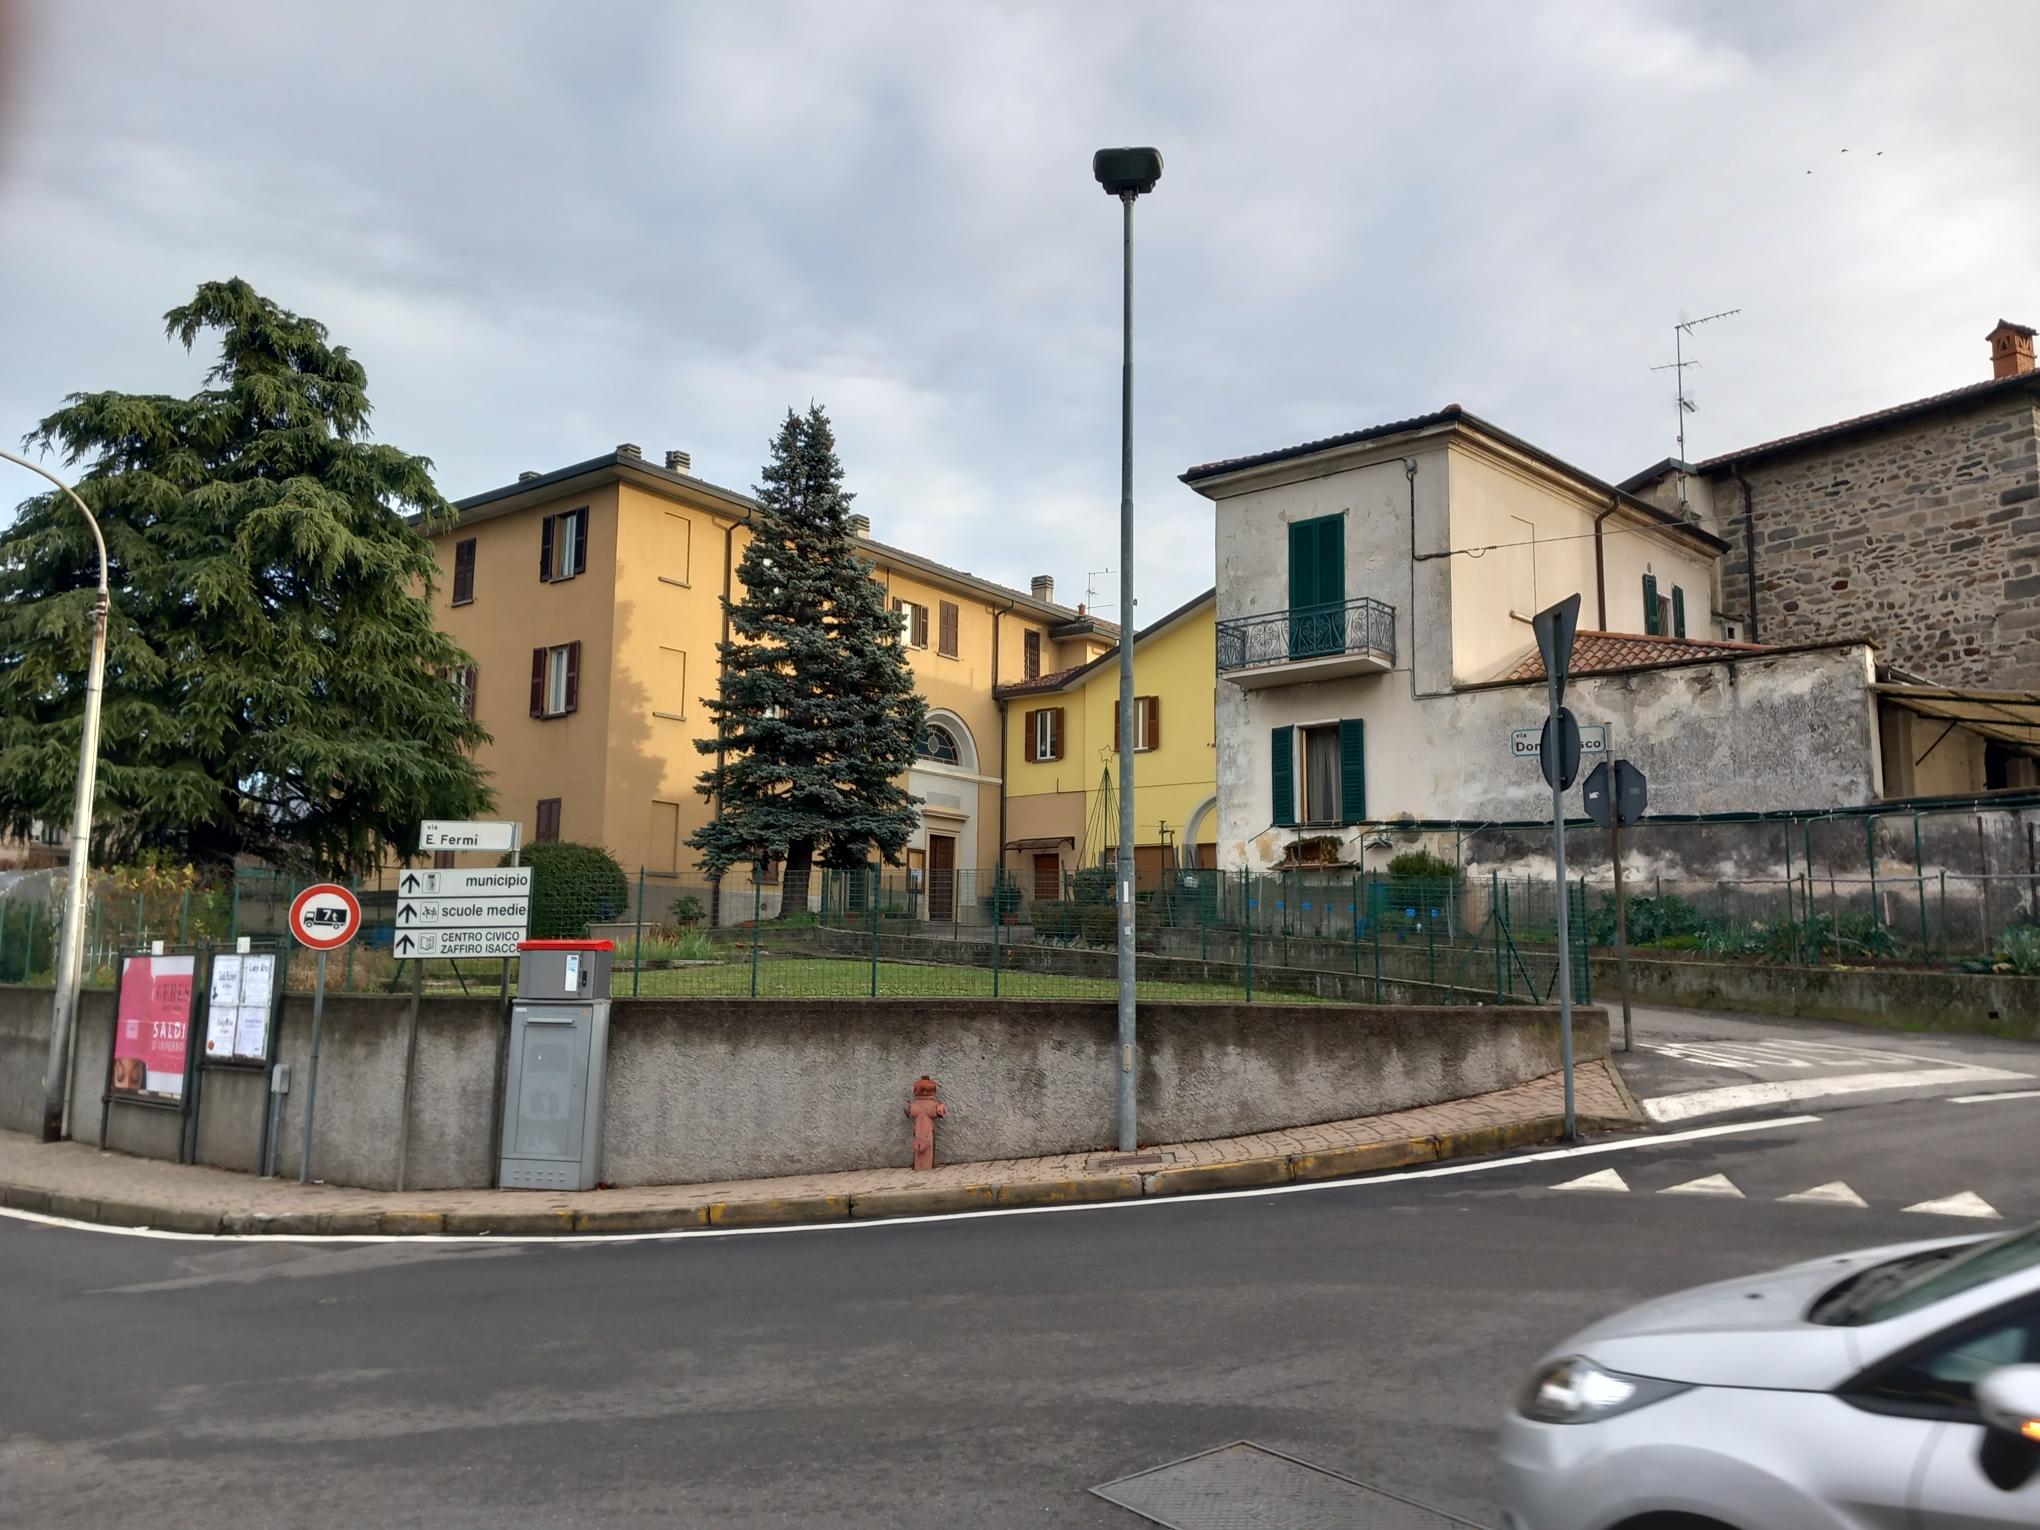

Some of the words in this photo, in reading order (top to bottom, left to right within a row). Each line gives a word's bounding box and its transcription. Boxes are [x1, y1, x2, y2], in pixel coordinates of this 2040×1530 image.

[440, 833, 479, 845] Fermi
[465, 873, 528, 888] municipio
[441, 904, 483, 917] scuole
[487, 903, 527, 916] medie
[441, 932, 482, 942] CENTRO
[485, 931, 520, 941] CIVICO
[440, 944, 482, 954] ZAFFIRO
[153, 1021, 186, 1040] SALDI
